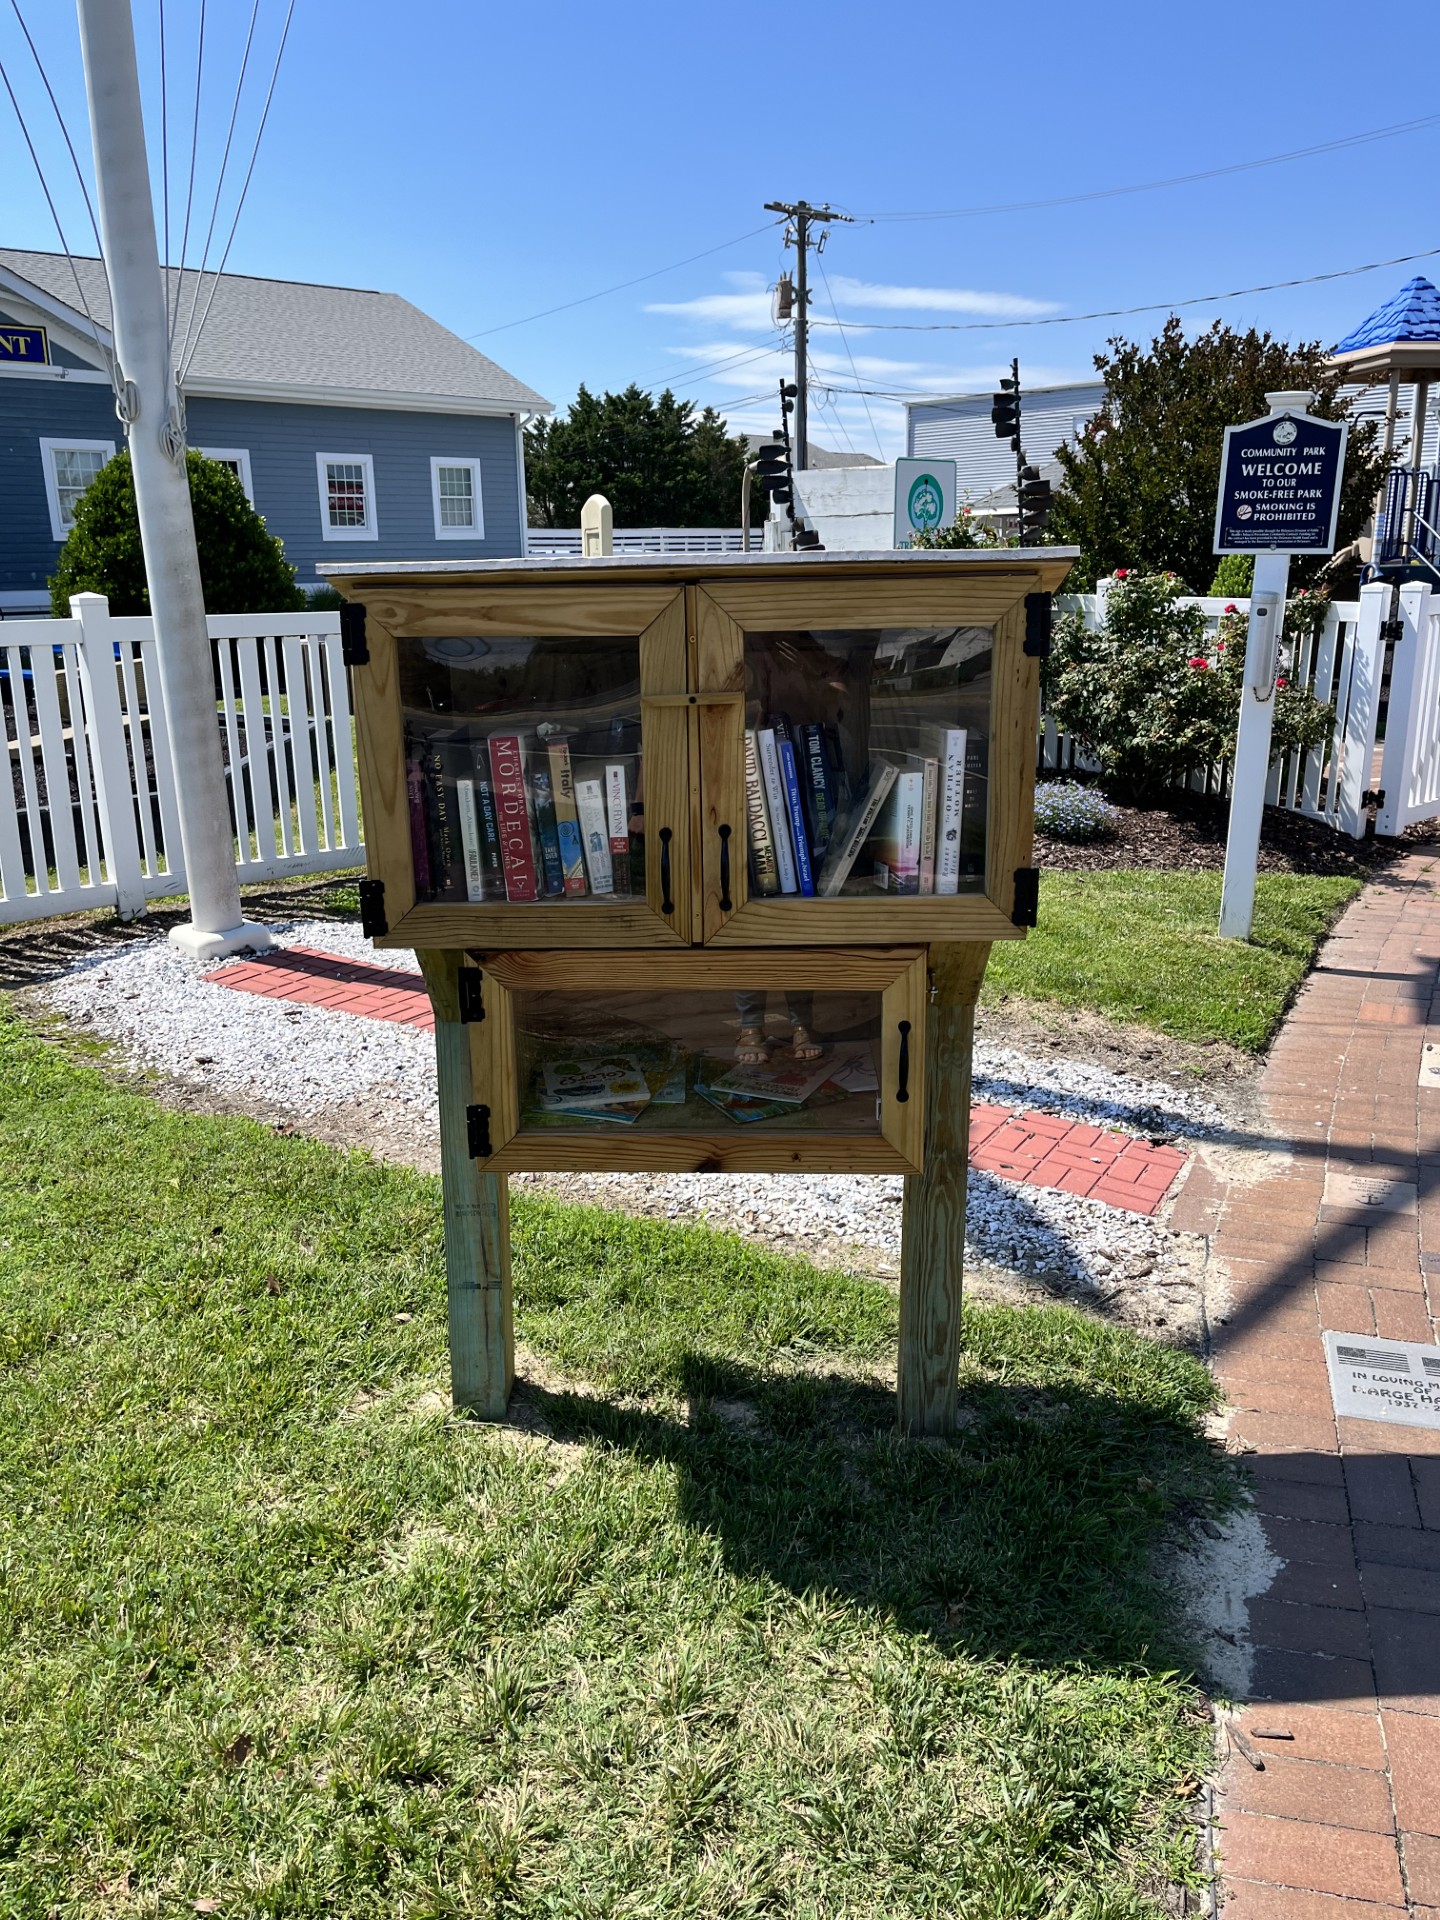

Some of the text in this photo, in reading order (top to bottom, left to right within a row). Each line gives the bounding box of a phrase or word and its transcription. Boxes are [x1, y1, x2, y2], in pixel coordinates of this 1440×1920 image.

[1241, 447, 1326, 458] COMMUNITY PARK
[1242, 462, 1322, 476] WELCOME
[1262, 478, 1296, 487] TO OUR
[1234, 489, 1322, 499] SMOKE-FREE PARK
[1253, 512, 1316, 521] PROHIBITED
[434, 755, 441, 770] NO
[765, 743, 774, 775] Surrender
[808, 734, 826, 790] TOM CLANCY
[435, 774, 445, 798] EASY
[480, 782, 489, 797] NOT
[512, 750, 524, 815] CHARLES FORAN
[560, 770, 572, 799] Italy
[745, 736, 767, 841] DAVID BALDACCI
[496, 741, 528, 880] MORDECAI
[816, 792, 826, 810] DEAD
[438, 802, 446, 822] DAY
[483, 805, 492, 822] DAY
[792, 806, 800, 826] Trump
[486, 822, 495, 843] CARE
[469, 850, 479, 882] FAULKNER
[754, 848, 767, 875] MAN
[764, 845, 774, 873] MEMORY
